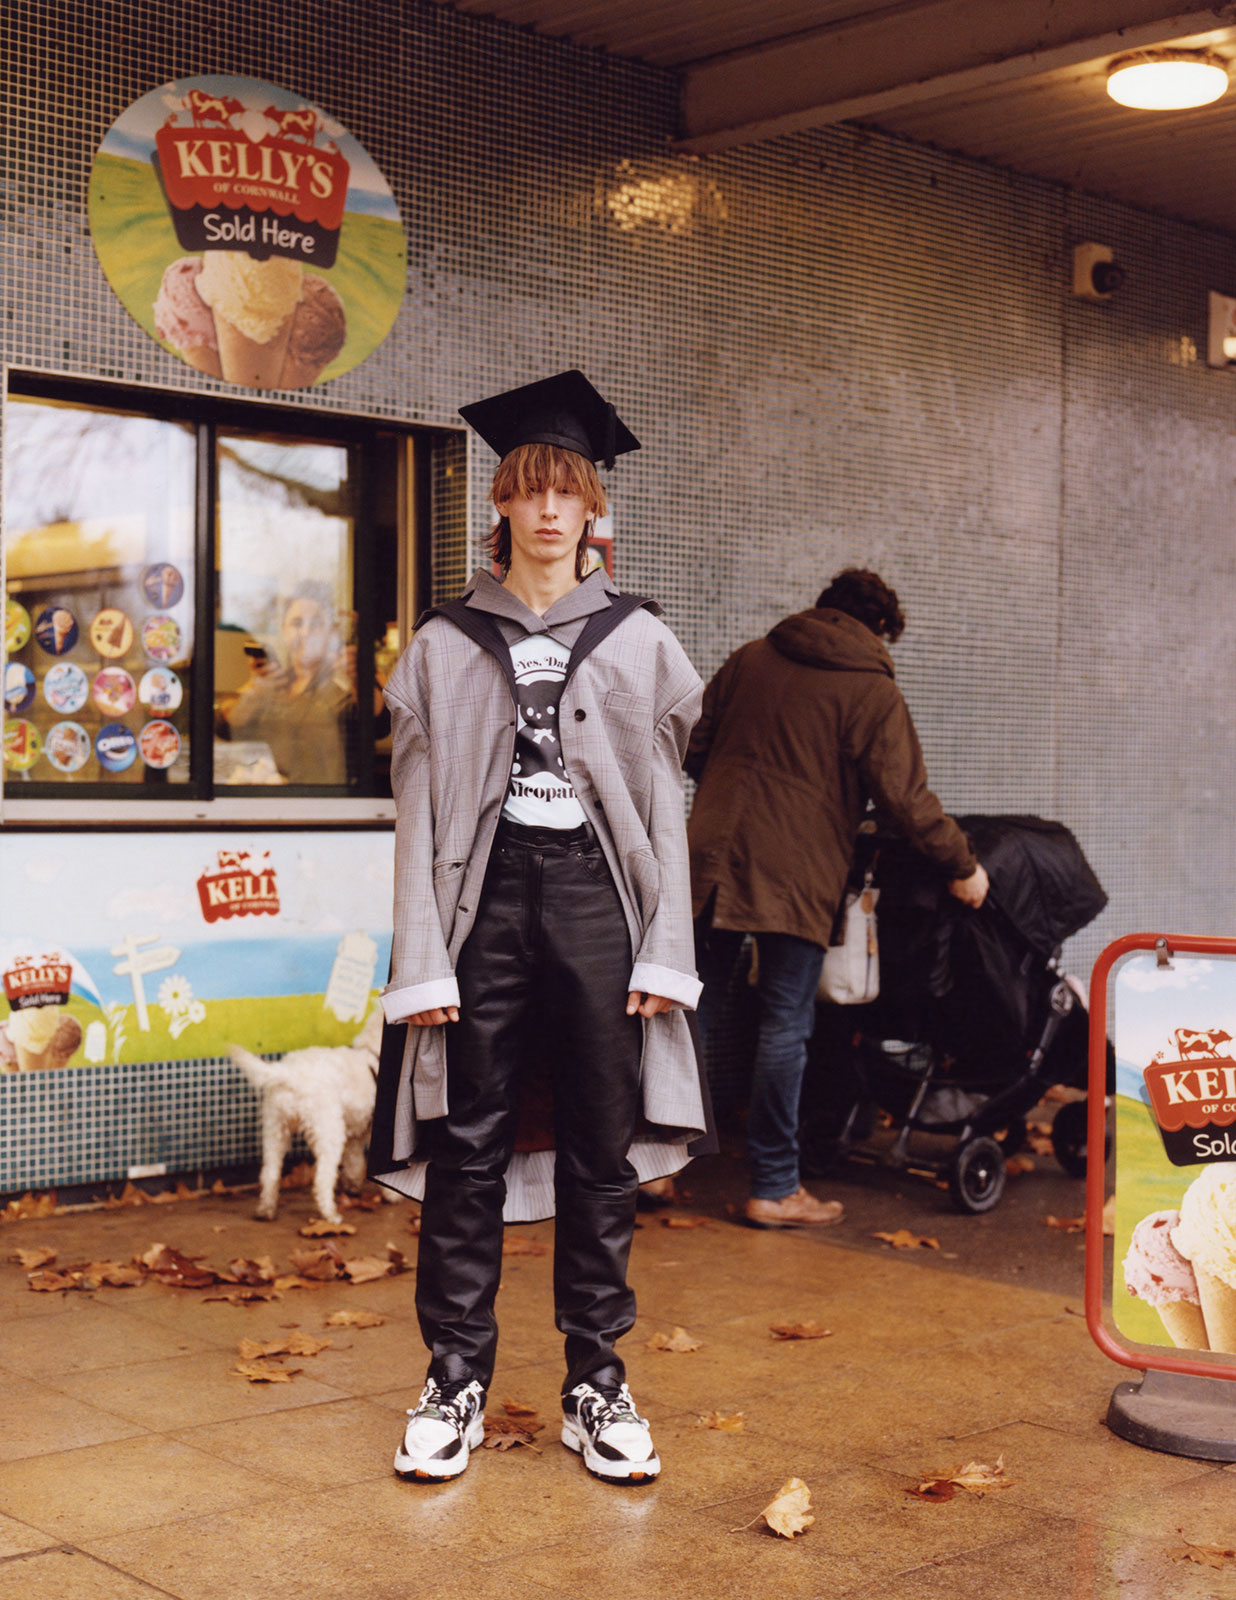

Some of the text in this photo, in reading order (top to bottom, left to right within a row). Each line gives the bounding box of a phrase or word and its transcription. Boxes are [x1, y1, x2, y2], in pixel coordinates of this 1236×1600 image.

[174, 140, 334, 199] KELLY'S
[213, 182, 301, 205] OF CORNWALL
[203, 213, 316, 253] Sold Here
[1201, 1103, 1219, 1114] OF
